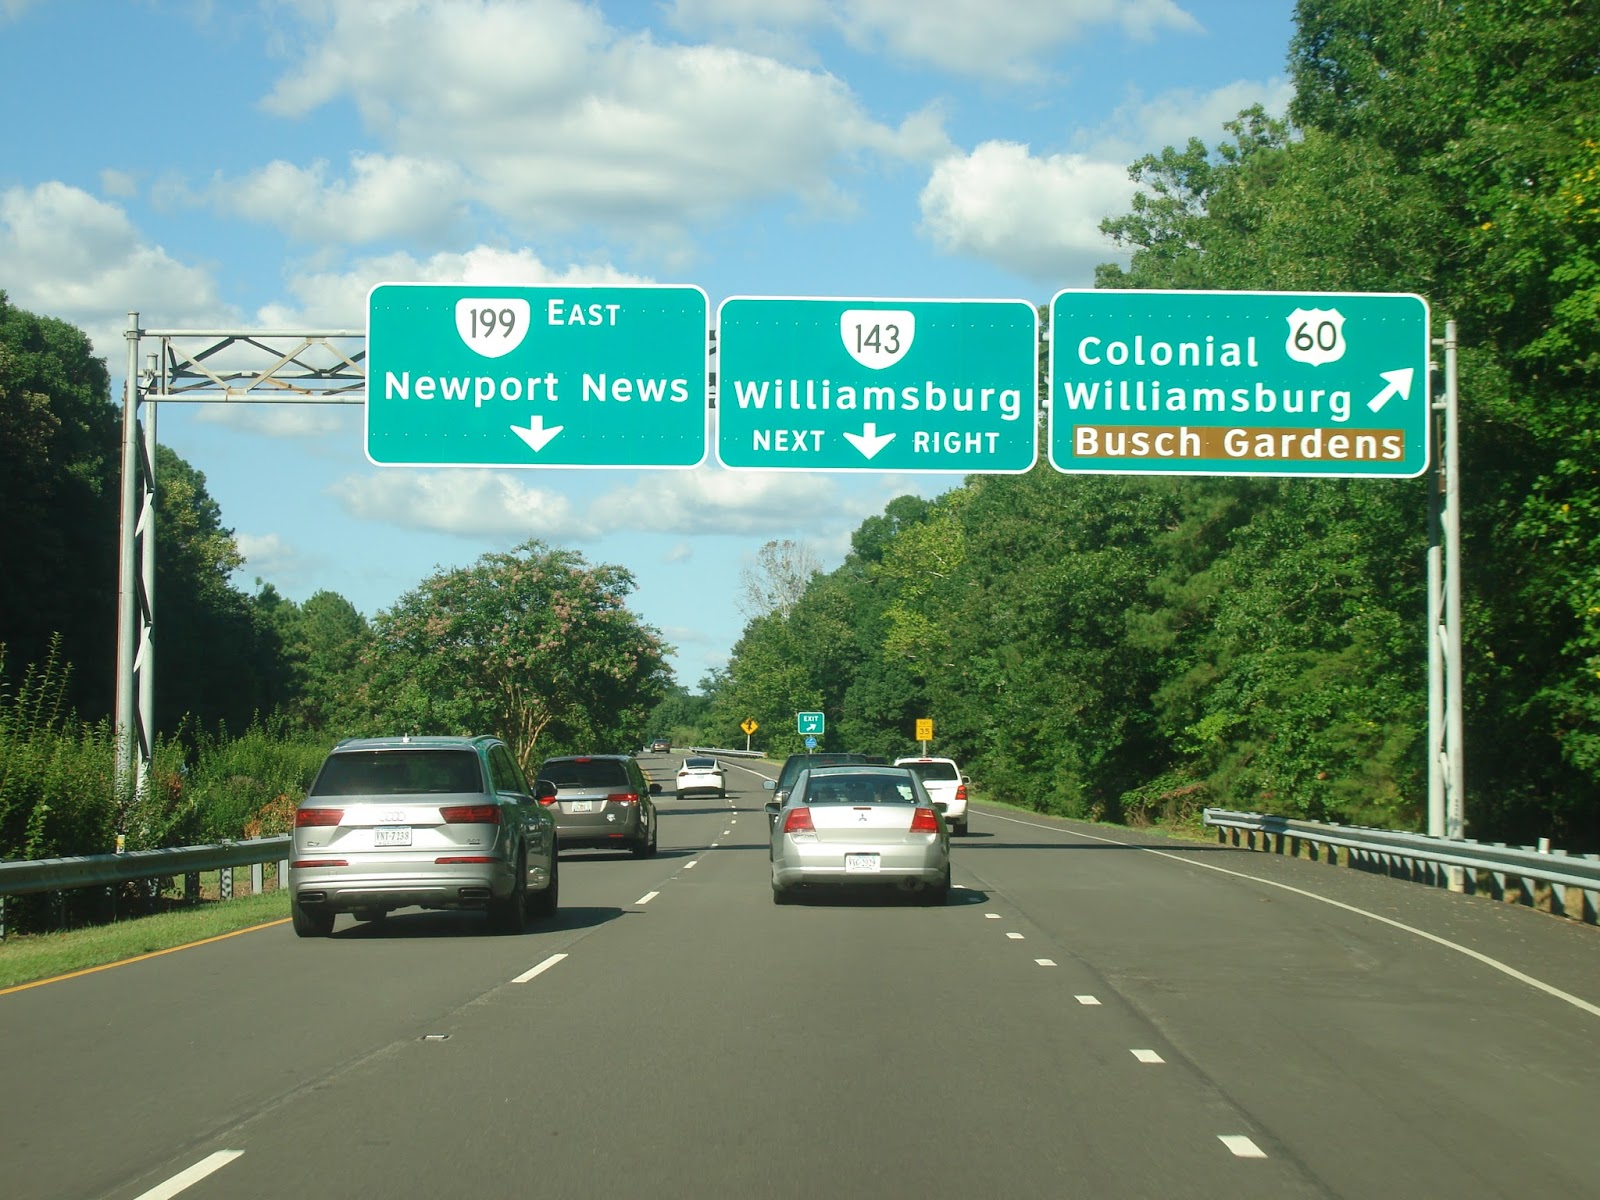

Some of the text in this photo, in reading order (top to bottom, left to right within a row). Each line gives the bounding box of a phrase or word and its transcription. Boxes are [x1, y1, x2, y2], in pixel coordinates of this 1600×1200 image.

[469, 307, 516, 339] 199
[549, 298, 621, 326] EAST
[854, 323, 901, 354] 143
[1077, 335, 1259, 368] Colonial
[1294, 320, 1337, 352] 60
[385, 371, 689, 408] Newport News
[733, 378, 1021, 422] Williamsburg
[1063, 379, 1352, 423] Williamsburg
[753, 429, 1000, 454] NEXT RIGHT
[1076, 426, 1402, 460] Busch Gardens
